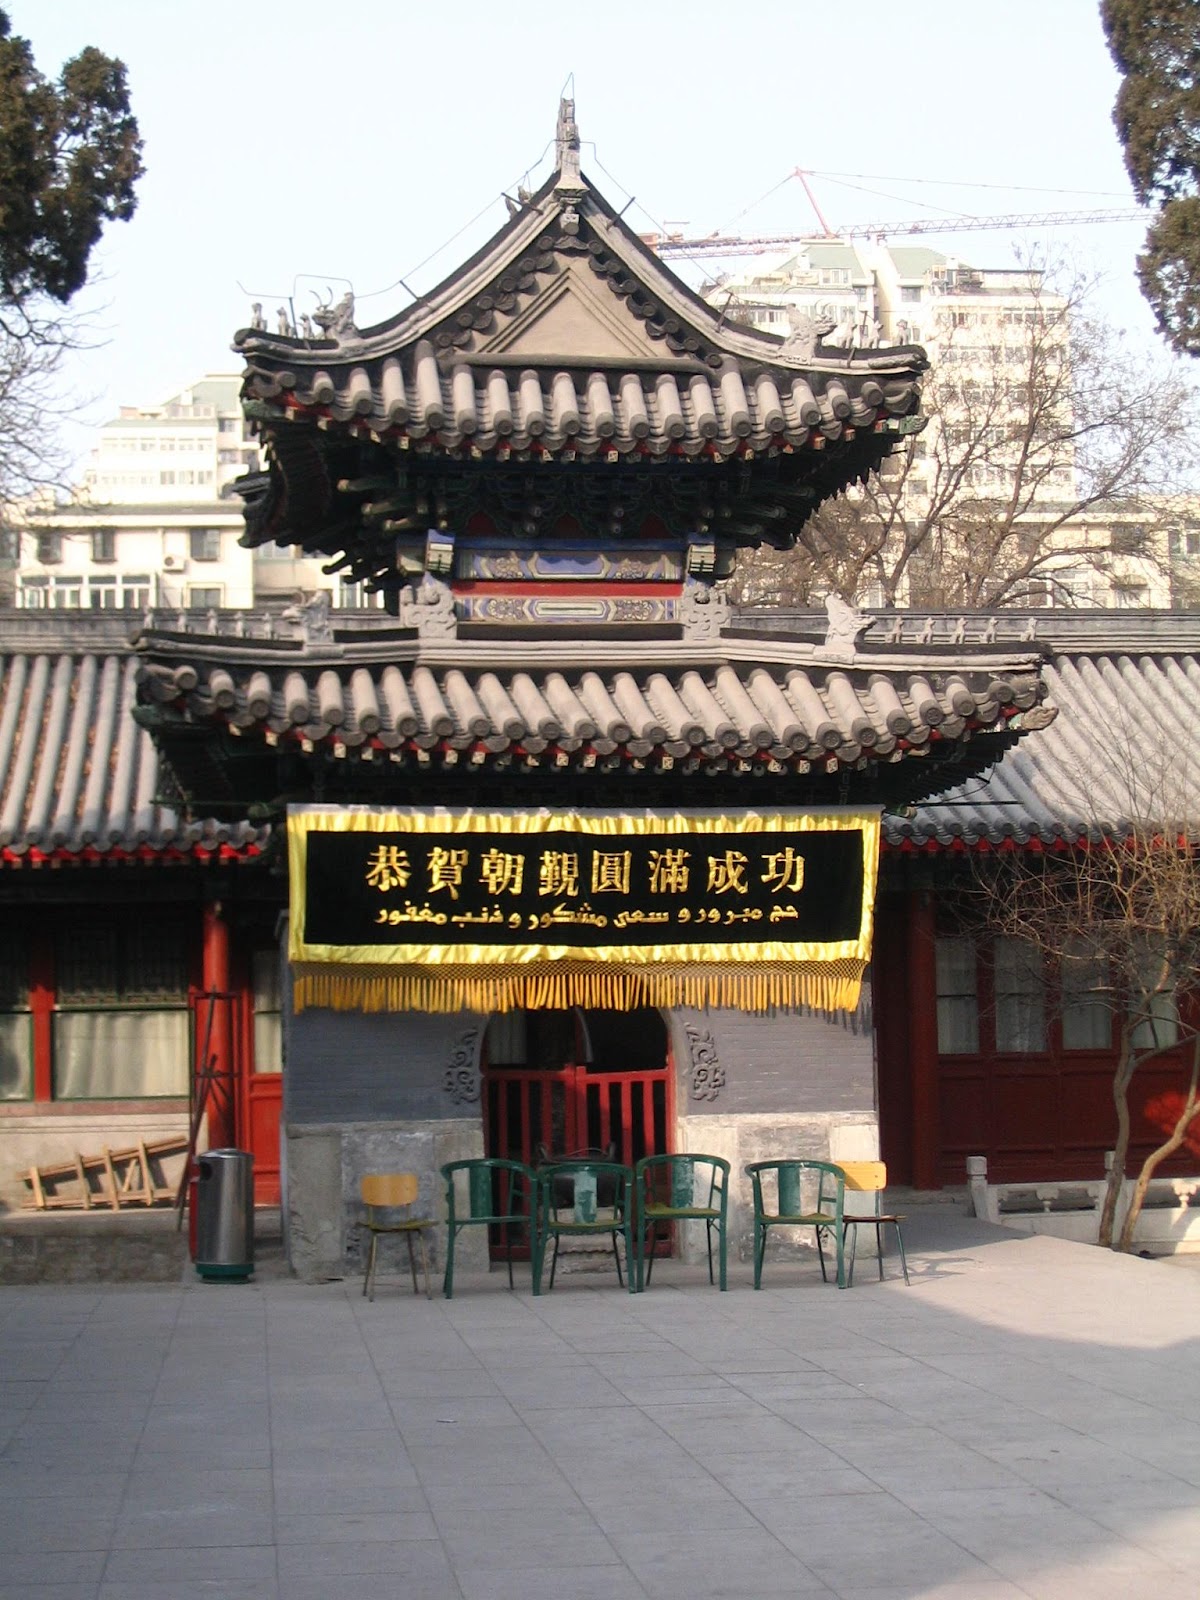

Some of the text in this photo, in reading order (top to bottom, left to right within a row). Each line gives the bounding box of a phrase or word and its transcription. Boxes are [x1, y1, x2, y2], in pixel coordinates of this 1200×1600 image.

[365, 844, 805, 899] 恭賀朝覲圓滿成功
[375, 900, 448, 926] مغفور
[450, 903, 504, 928] ذنب
[508, 912, 522, 929] و
[527, 902, 608, 930] مشكور
[677, 907, 691, 923] و
[694, 907, 763, 925] مبرور
[769, 904, 799, 923] حج
